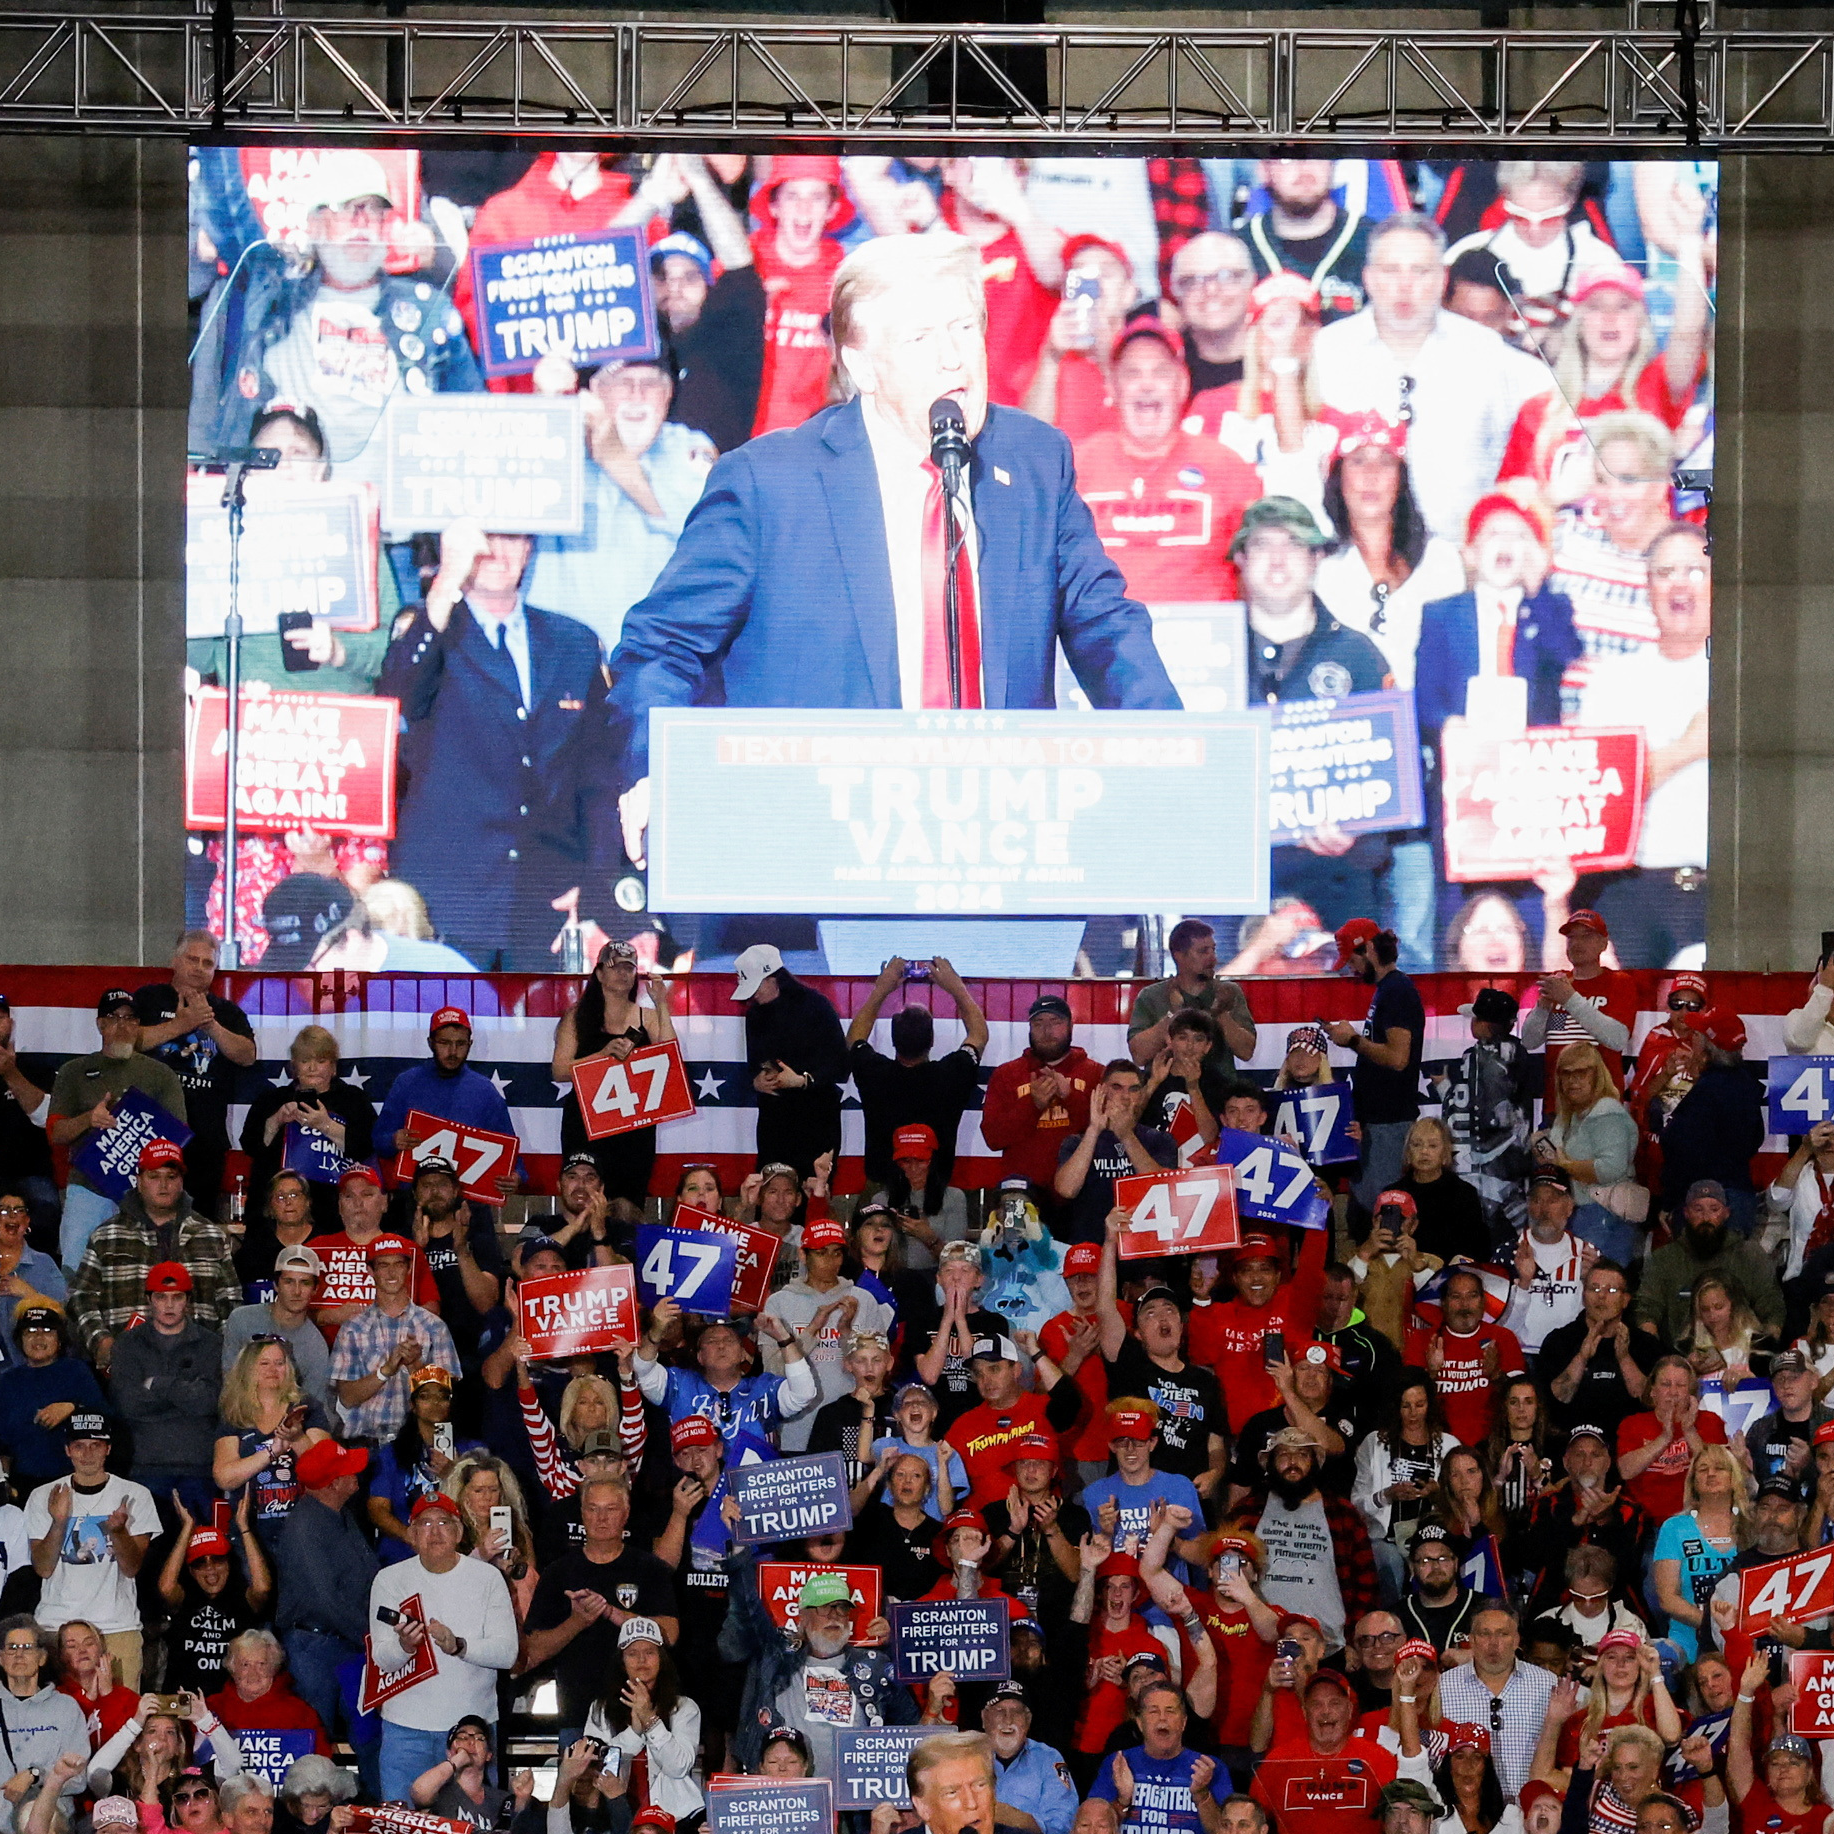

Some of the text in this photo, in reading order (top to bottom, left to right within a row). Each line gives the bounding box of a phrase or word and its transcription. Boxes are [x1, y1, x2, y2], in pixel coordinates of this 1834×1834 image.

[501, 243, 616, 279] SCRANTON
[487, 266, 635, 303] FIREFIGHTERS
[495, 307, 636, 360] TRUMP
[244, 705, 340, 734] MAKE
[212, 730, 366, 767] AMERICA
[725, 736, 805, 763] TEXT
[1054, 738, 1094, 763] TO
[236, 759, 345, 789] GREAT
[235, 789, 346, 820] AGAIN!
[818, 769, 1103, 821] TRUMP
[848, 822, 1070, 864] VANCE
[592, 1054, 670, 1116] 47
[1233, 1147, 1315, 1209] 47
[1129, 1180, 1222, 1242] 47
[641, 1238, 722, 1298] 47
[524, 1287, 629, 1318] TRUMP
[531, 1330, 556, 1339] MAKE
[556, 1325, 592, 1337] AMERICA
[534, 1307, 619, 1332] VANCE
[571, 1345, 592, 1354] 2024
[1447, 1370, 1468, 1380] VOTED
[738, 1478, 838, 1501] FIREFIGHTERS
[747, 1467, 824, 1487] SCRANTON
[779, 1497, 799, 1507] FOR
[744, 1503, 839, 1534] TRUMP
[191, 1618, 237, 1631] CALM
[911, 1608, 987, 1623] SCRANTON
[202, 1632, 220, 1640] AND
[625, 1623, 657, 1639] USA
[901, 1621, 999, 1637] FIREFIGHTERS
[939, 1637, 960, 1647] FOR
[197, 1658, 221, 1671] ON
[905, 1649, 998, 1674] TRUMP
[728, 1797, 809, 1813] SCRANTON
[1141, 1810, 1167, 1824] FOR
[717, 1808, 821, 1828] FIREFIGHTERS
